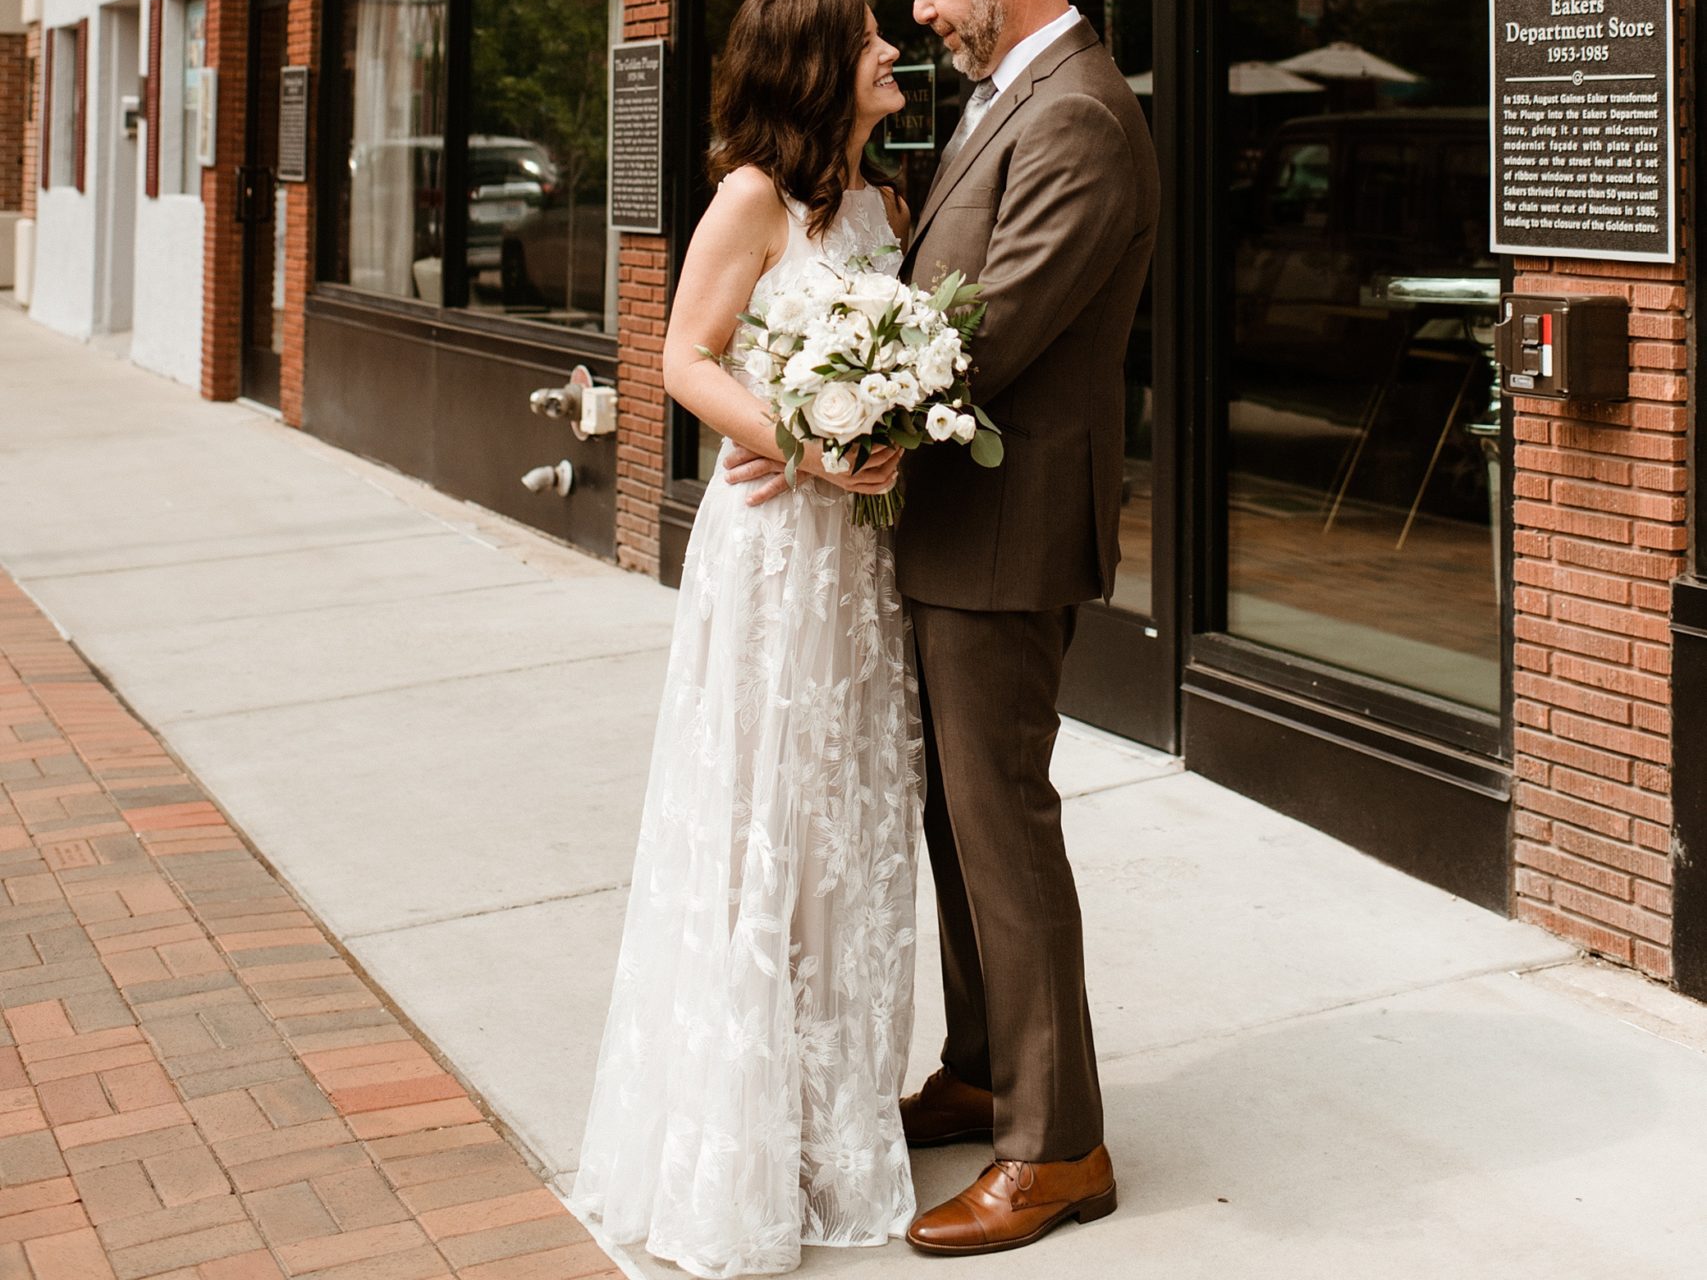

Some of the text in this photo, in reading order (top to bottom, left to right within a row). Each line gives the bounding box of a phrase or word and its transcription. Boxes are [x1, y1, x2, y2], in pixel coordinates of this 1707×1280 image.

[1506, 17, 1654, 45] Department Store
[1548, 45, 1609, 62] 1953-1985
[1504, 92, 1657, 106] In 1953, August Gaines Eaker transformed
[1504, 109, 1658, 121] The Plunge into the Eakers Department
[1504, 125, 1658, 137] Store, giving it a new mid-century
[1504, 141, 1658, 153] modernist façade with plate glass
[1504, 156, 1658, 167] windows on the street level and a set
[1504, 171, 1658, 183] of ribbon windows on the second floor.
[1504, 186, 1658, 201] Eakers thrived for more than 50 years until
[1504, 201, 1658, 217] the chain went out of business in 1985,
[1504, 216, 1658, 232] leading to the closure of the Golden store.
